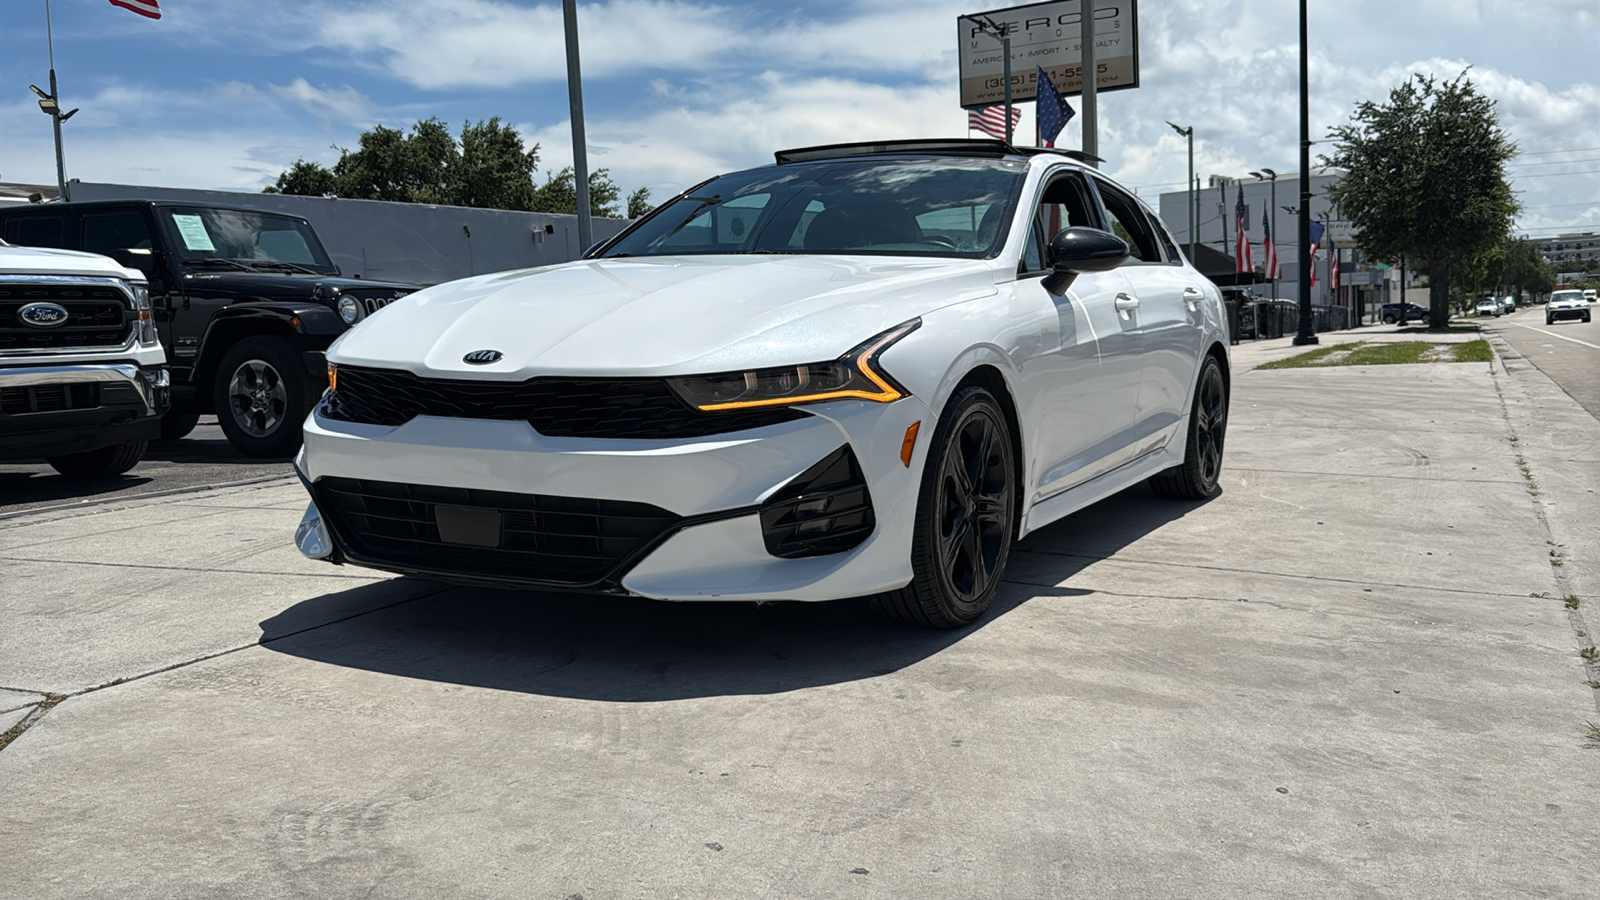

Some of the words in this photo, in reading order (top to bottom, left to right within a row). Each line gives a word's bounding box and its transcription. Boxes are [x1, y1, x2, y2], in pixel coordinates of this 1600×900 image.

[972, 53, 1015, 65] AMERICN
[1028, 47, 1060, 57] IMPORT
[1074, 39, 1120, 51] SIALTY
[1029, 63, 1108, 83] 51-555
[34, 309, 59, 321] Ford
[467, 350, 496, 361] KIA
